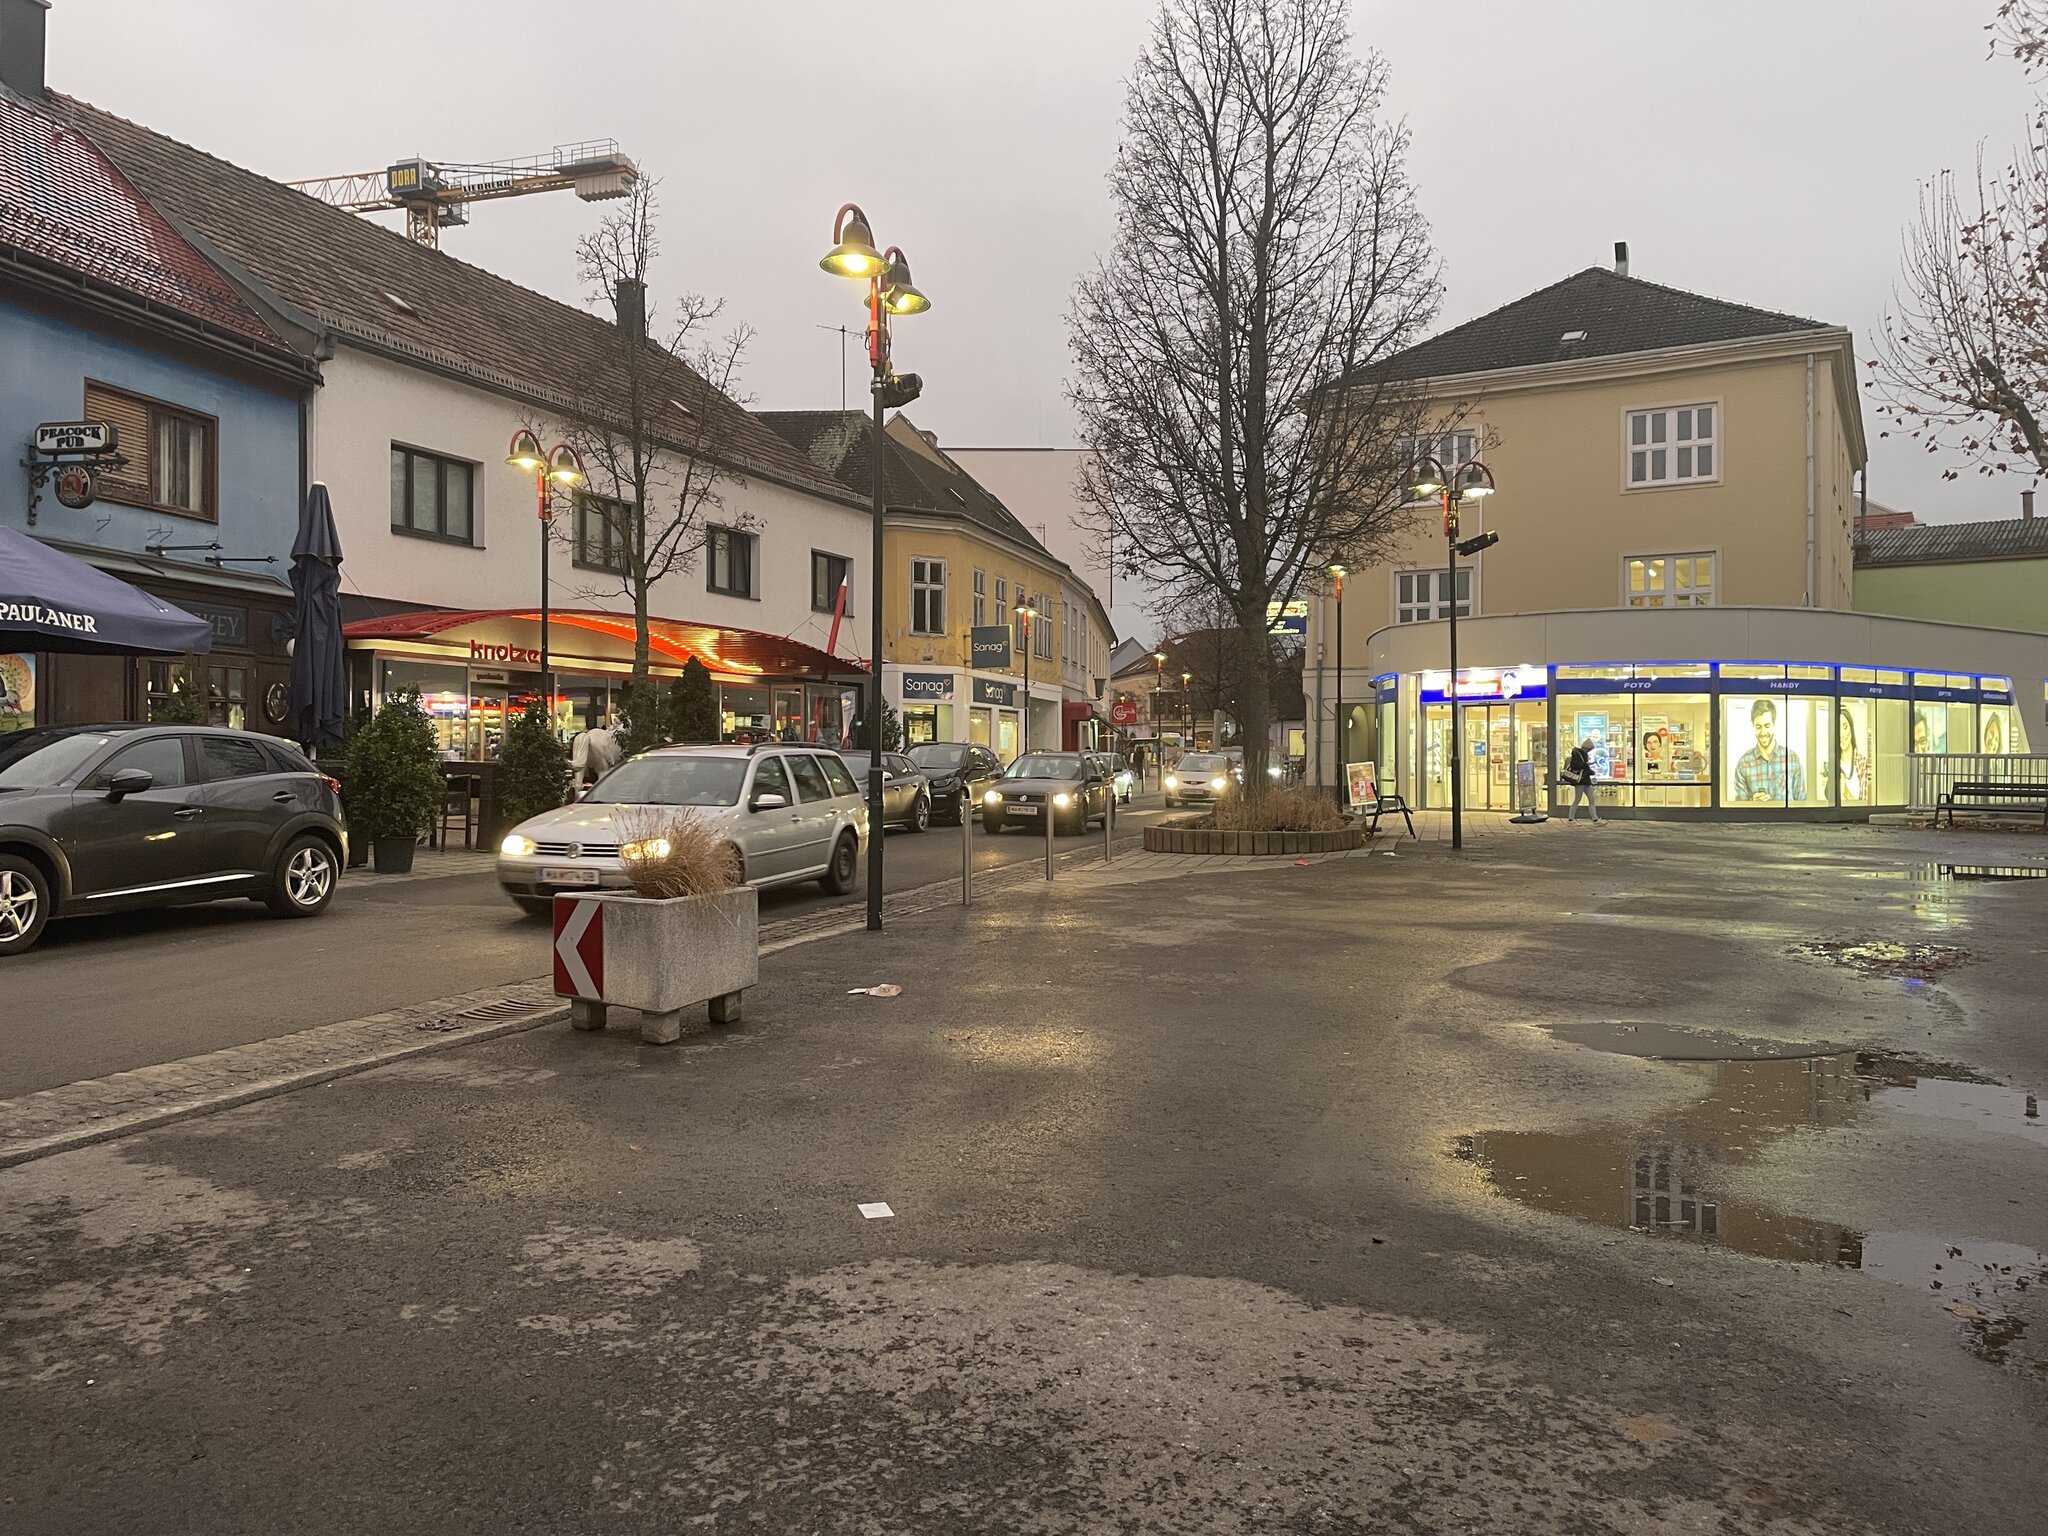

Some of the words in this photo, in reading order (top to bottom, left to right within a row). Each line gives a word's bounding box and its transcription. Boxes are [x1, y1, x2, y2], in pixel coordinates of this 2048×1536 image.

[40, 426, 102, 442] PEACOCK
[56, 436, 85, 448] PUB
[0, 602, 98, 634] PAULANER
[469, 639, 542, 664] knotze
[973, 643, 1003, 653] Sanag
[905, 678, 944, 695] Sanag
